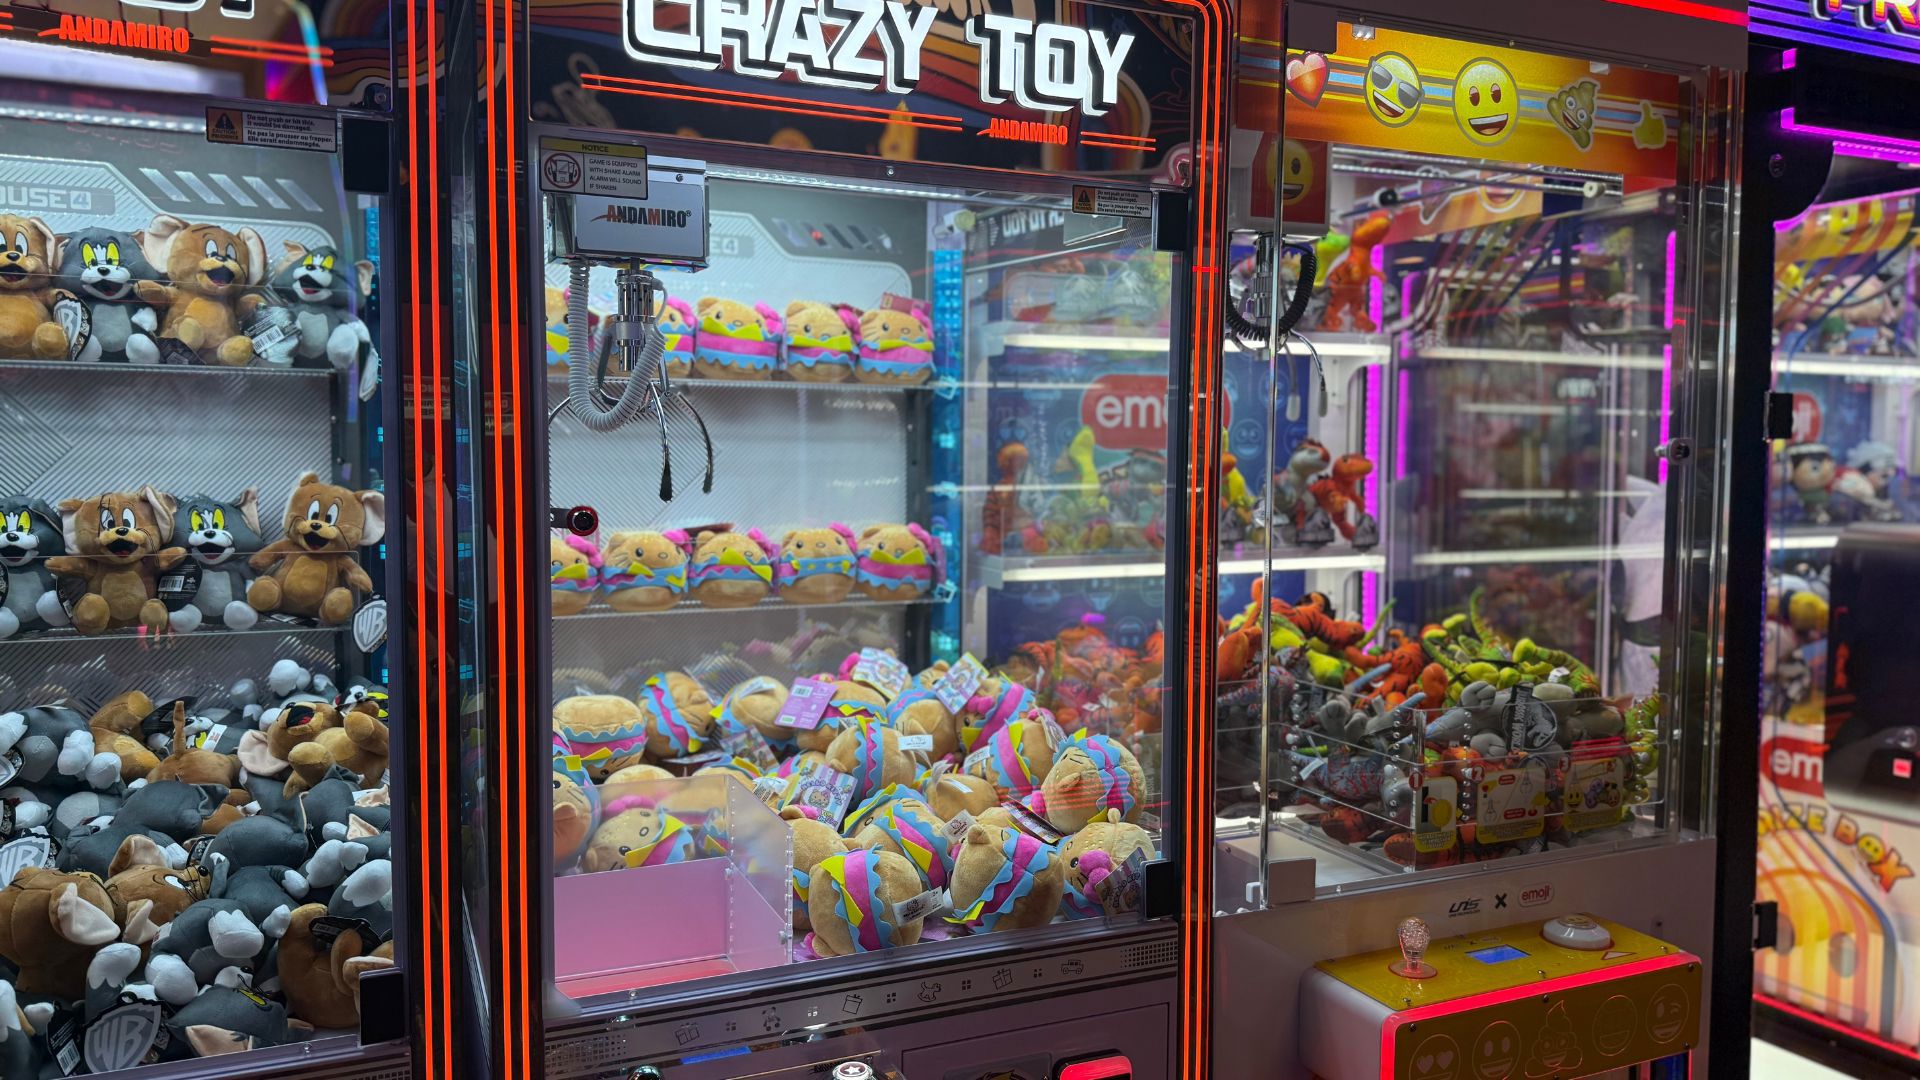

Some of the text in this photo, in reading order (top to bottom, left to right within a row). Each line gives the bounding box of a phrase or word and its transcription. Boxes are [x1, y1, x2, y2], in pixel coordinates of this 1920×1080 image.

[55, 14, 190, 53] ANDAMIRO
[622, 0, 1136, 117] CRAZY TOY
[269, 116, 284, 124] push
[986, 117, 1069, 146] ANDAMIRO
[275, 132, 300, 140] pousser
[581, 144, 609, 152] NOTICE
[1095, 395, 1168, 429] em
[1521, 884, 1552, 902] emoji
